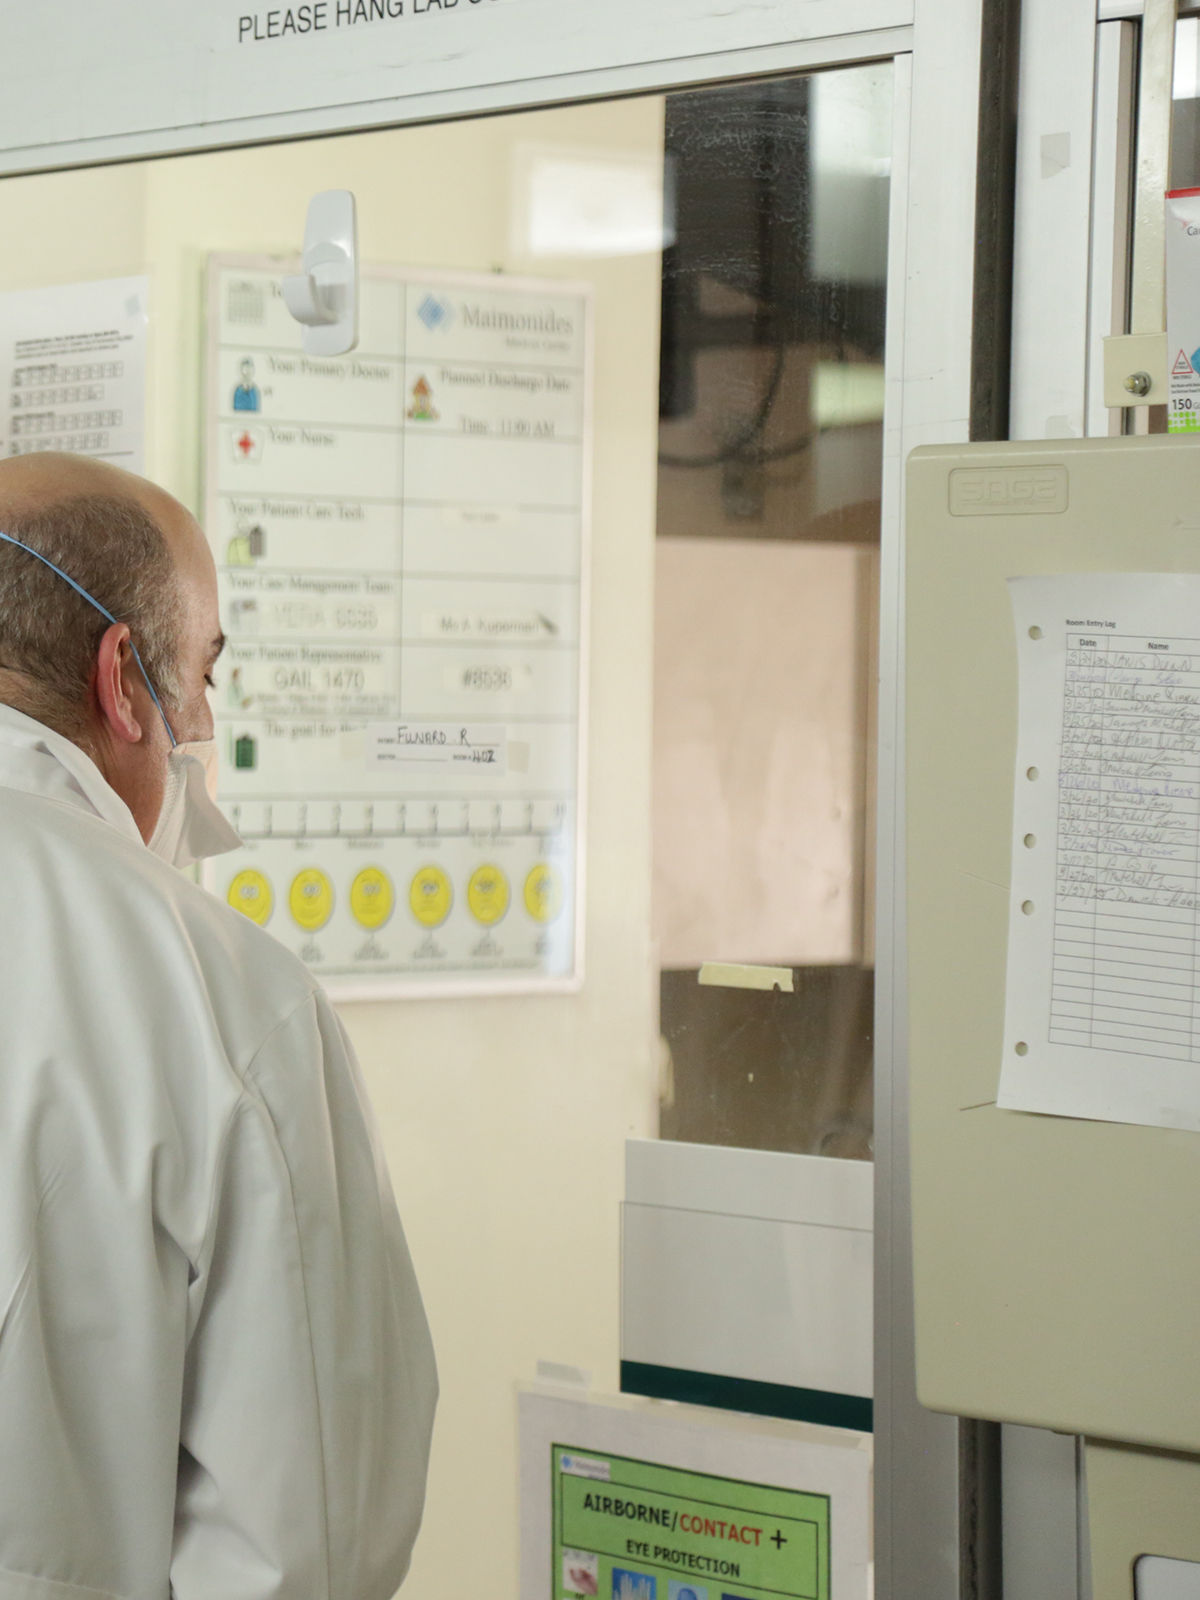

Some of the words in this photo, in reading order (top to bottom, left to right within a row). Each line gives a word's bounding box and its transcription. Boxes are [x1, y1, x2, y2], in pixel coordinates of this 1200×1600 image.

[238, 3, 328, 43] PLEASE
[336, 0, 404, 27] HANG
[462, 302, 574, 335] Maimonides
[300, 358, 347, 382] Primary
[351, 361, 391, 380] Doctor
[488, 371, 543, 393] Discharge
[546, 373, 571, 391] Date
[1172, 398, 1192, 410] 150
[301, 428, 335, 445] Nurse
[501, 417, 531, 437] 11:00
[532, 419, 556, 438] AM
[962, 477, 1056, 501] SAGE
[262, 500, 303, 516] Patient
[339, 502, 365, 519] Tech
[289, 576, 360, 594] Management
[364, 578, 393, 594] Team
[1066, 619, 1086, 627] Room
[1087, 619, 1104, 629] Entry
[1105, 621, 1116, 629] Log
[1080, 638, 1097, 647] Date
[1148, 642, 1169, 650] Name
[258, 646, 298, 661] Patient
[301, 646, 382, 664] Representative
[272, 665, 316, 692] GAIL
[322, 666, 365, 693] 1470
[291, 722, 317, 740] goal
[460, 727, 471, 747] R
[472, 749, 497, 763] 402
[1060, 806, 1099, 820] 3/26/20
[1059, 822, 1098, 836] 3/26/20
[584, 1492, 763, 1547] AIRBORNE/CONTACT
[626, 1539, 651, 1557] EYE
[653, 1544, 741, 1577] PROTECTION
